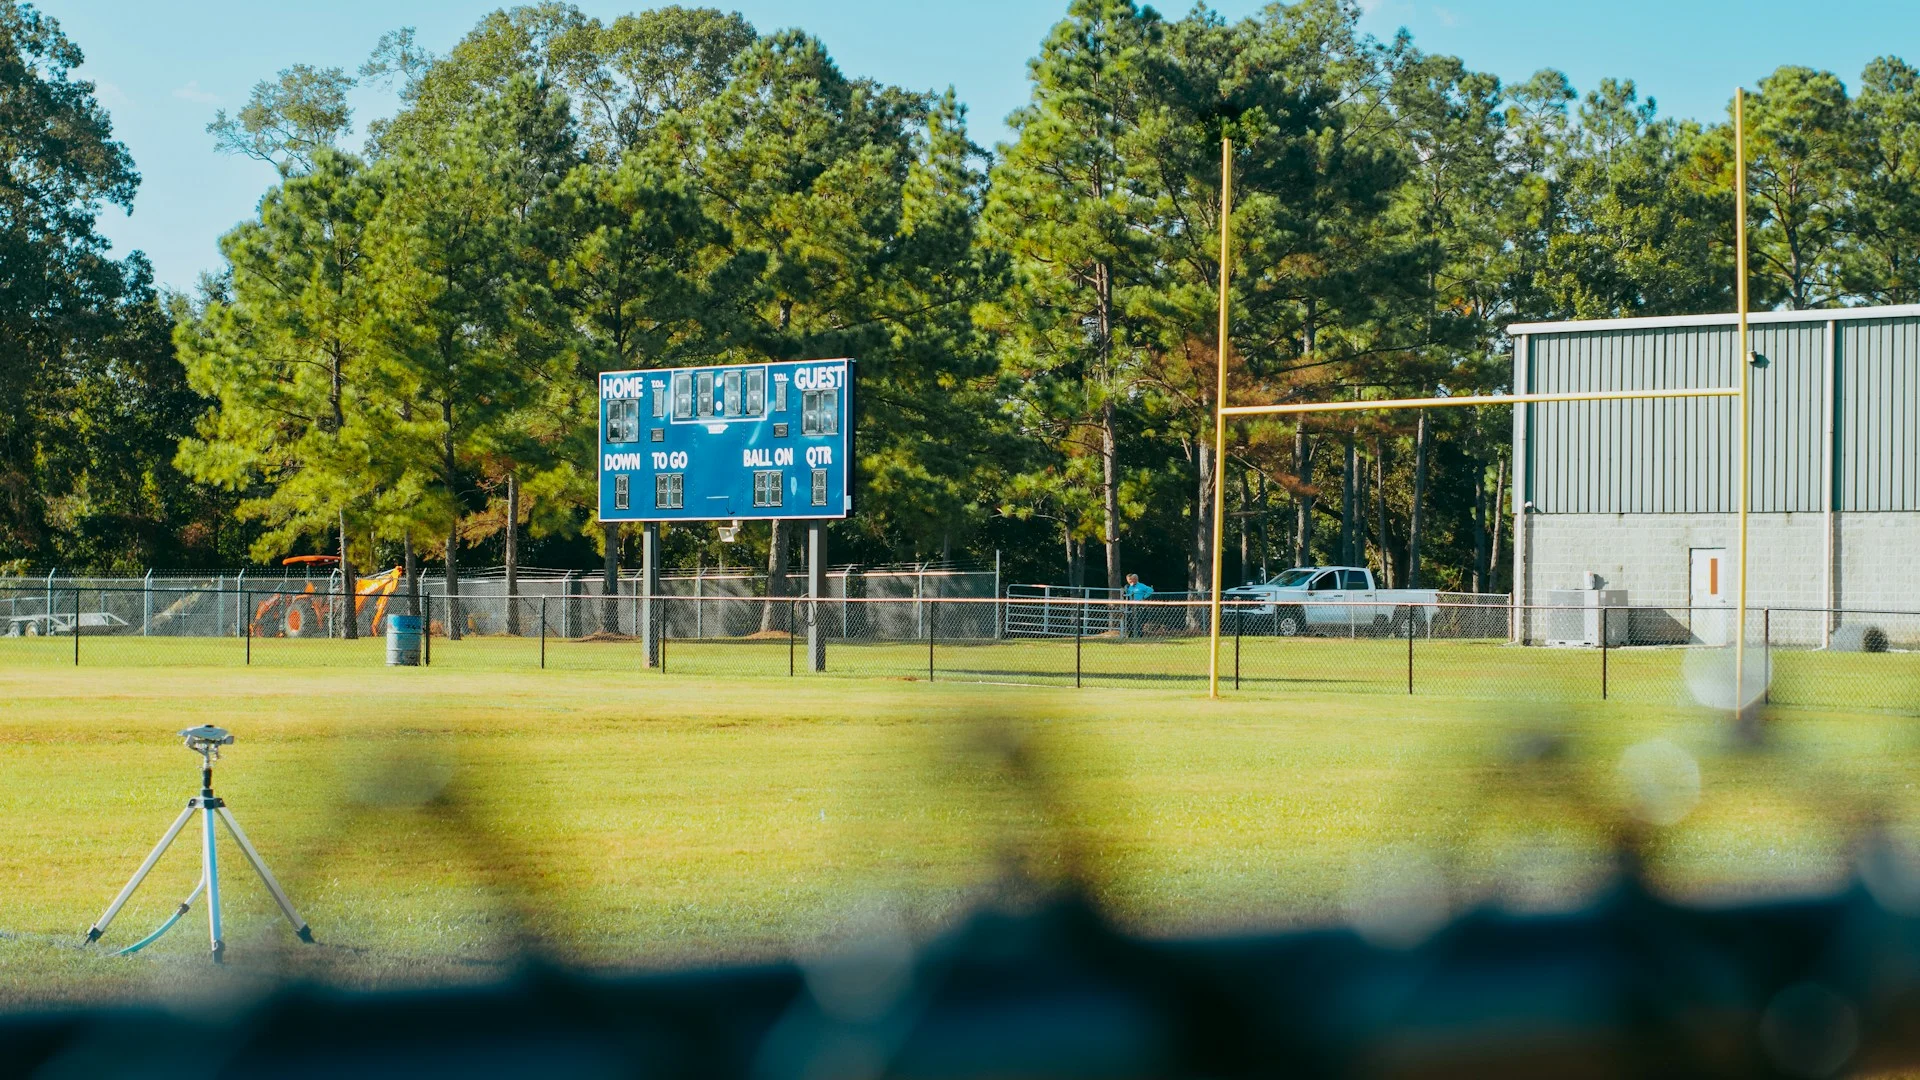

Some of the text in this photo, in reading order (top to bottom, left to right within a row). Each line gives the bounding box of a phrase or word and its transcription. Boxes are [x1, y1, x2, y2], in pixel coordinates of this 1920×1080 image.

[794, 365, 845, 390] GUEST
[602, 377, 643, 399] HOME
[604, 453, 640, 471] DOWN
[651, 451, 688, 470] TO GO
[743, 448, 793, 467] BALL ON
[806, 446, 832, 468] QTR
